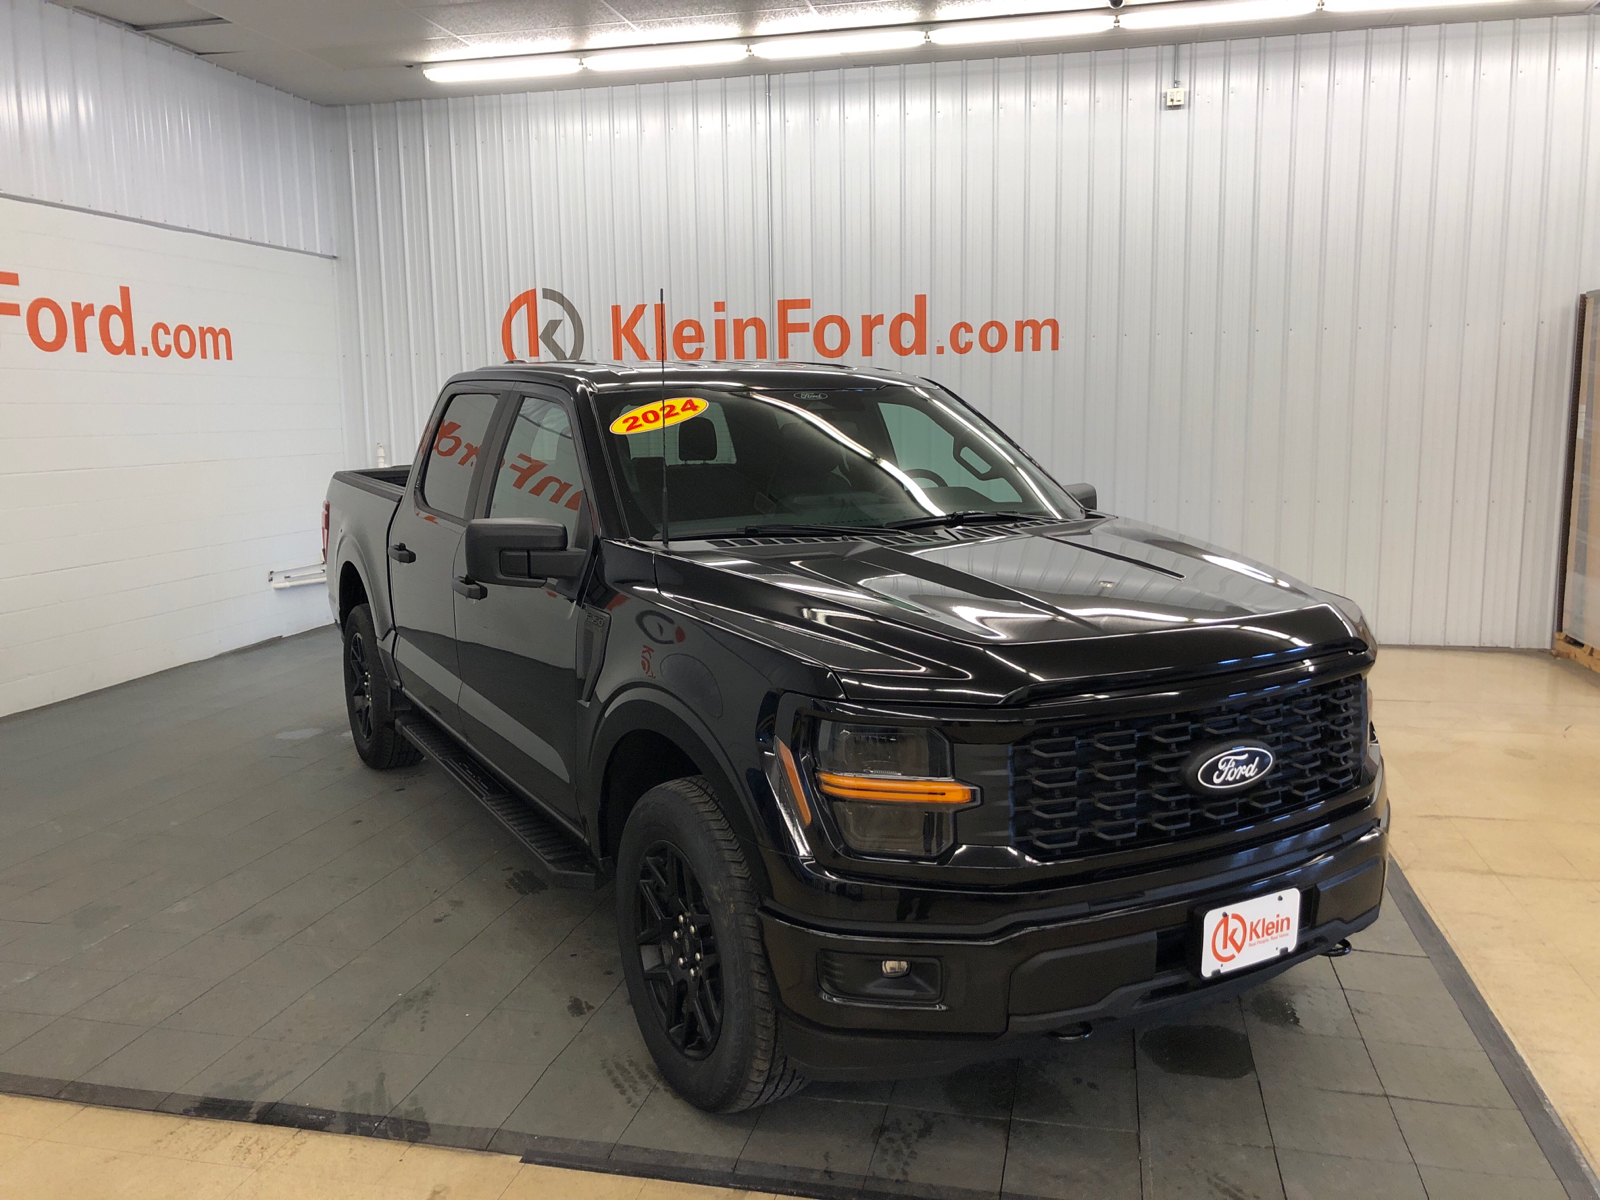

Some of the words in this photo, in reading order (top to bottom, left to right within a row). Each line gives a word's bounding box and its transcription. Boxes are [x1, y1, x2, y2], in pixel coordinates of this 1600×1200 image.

[611, 294, 1060, 361] KleinFord.com
[622, 398, 699, 432] 2024
[1212, 752, 1260, 784] Ford
[1249, 914, 1290, 941] Klein
